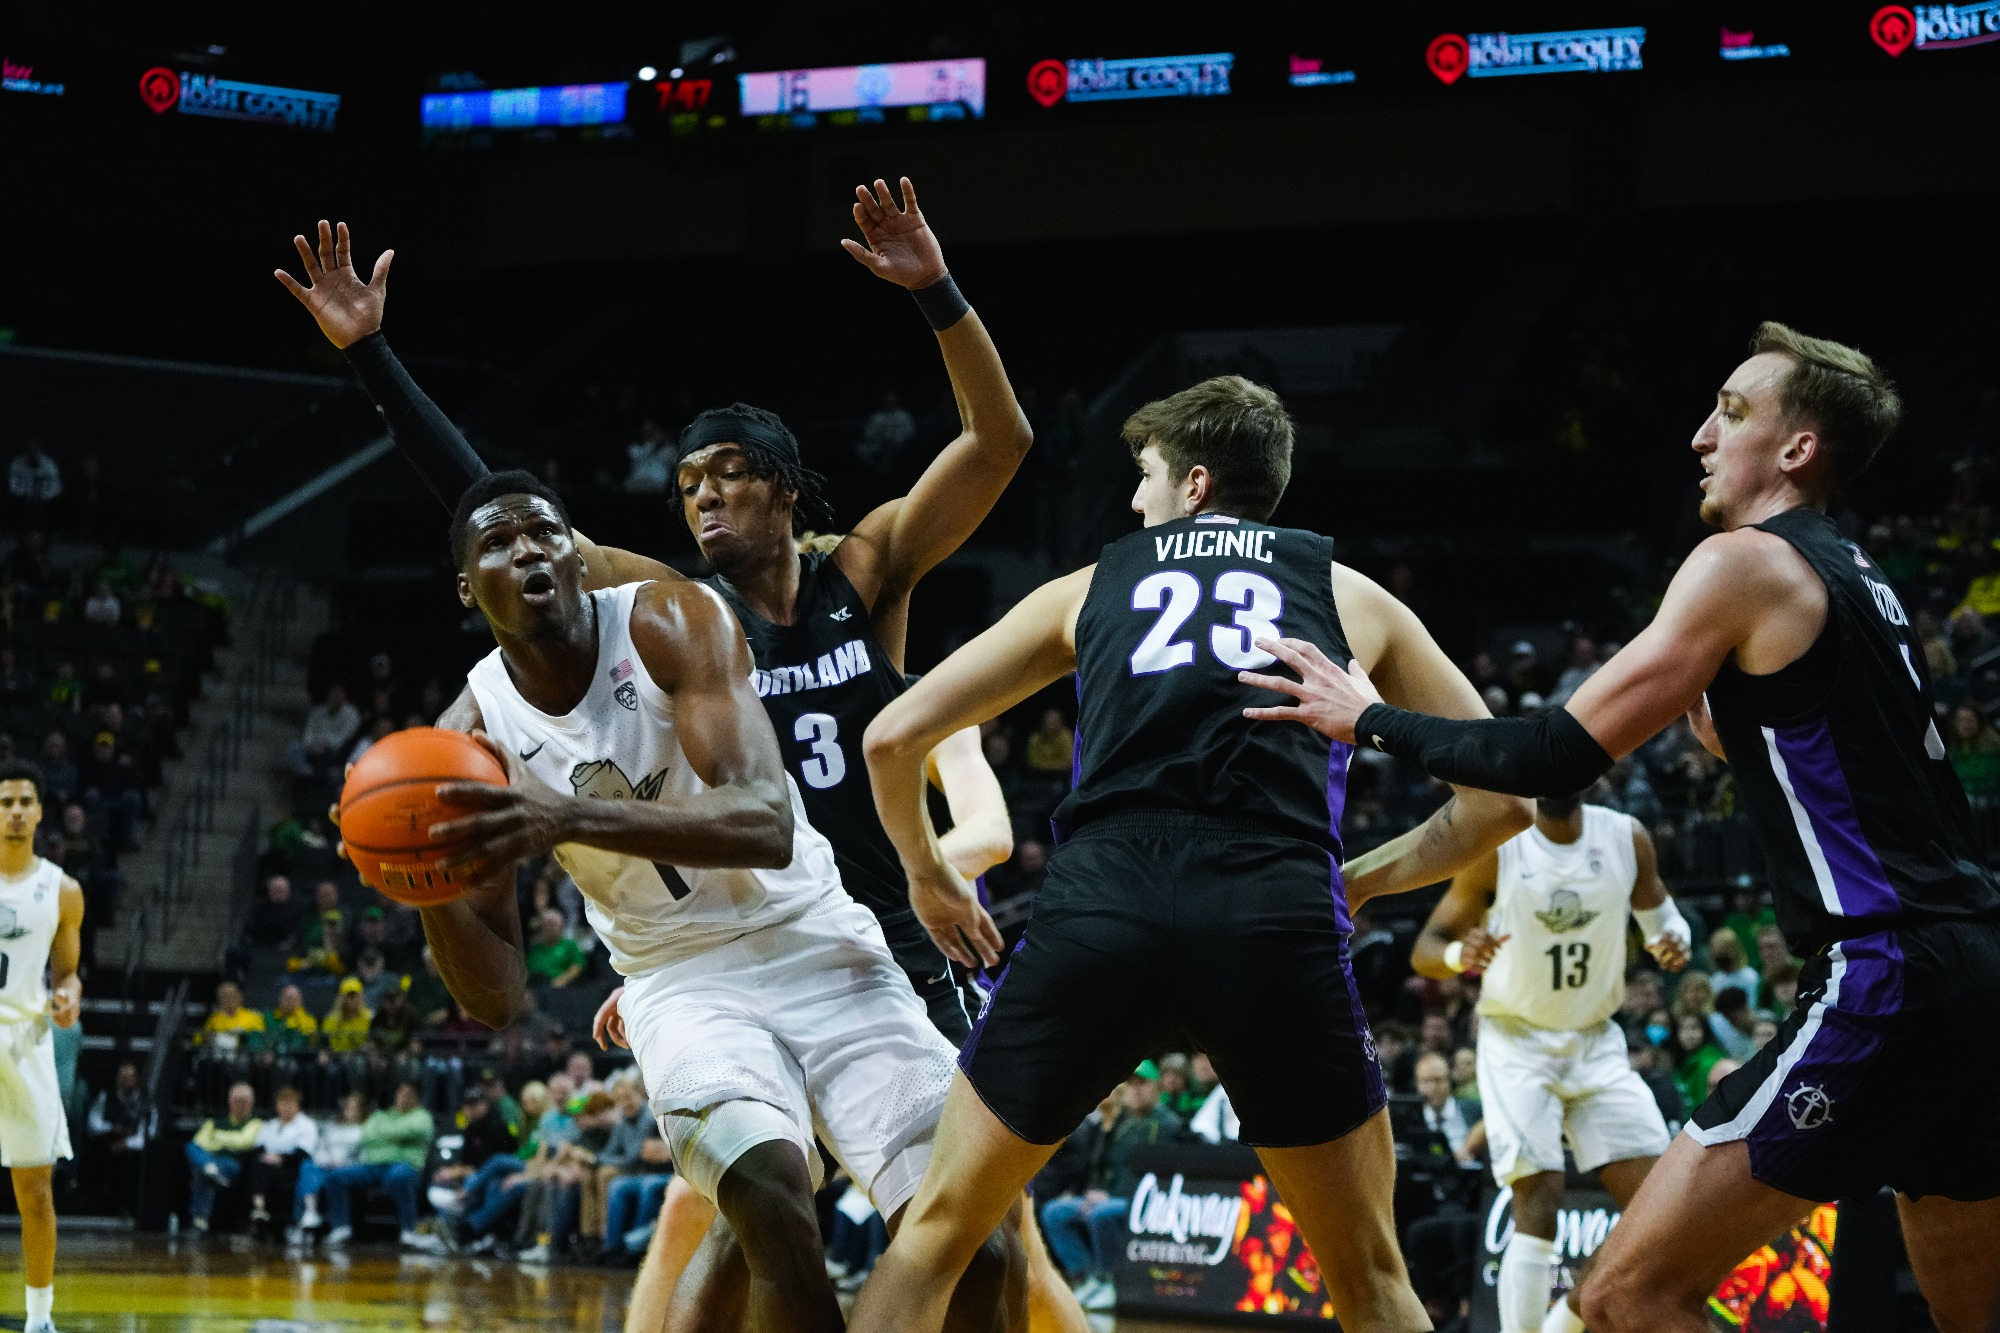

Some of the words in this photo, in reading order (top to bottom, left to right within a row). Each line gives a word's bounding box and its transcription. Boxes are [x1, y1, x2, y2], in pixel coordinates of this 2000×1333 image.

[1155, 530, 1275, 563] VUCINIC
[1128, 569, 1285, 677] 23
[755, 639, 871, 698] ORTLAND
[794, 712, 846, 790] 3
[1544, 942, 1592, 992] 13
